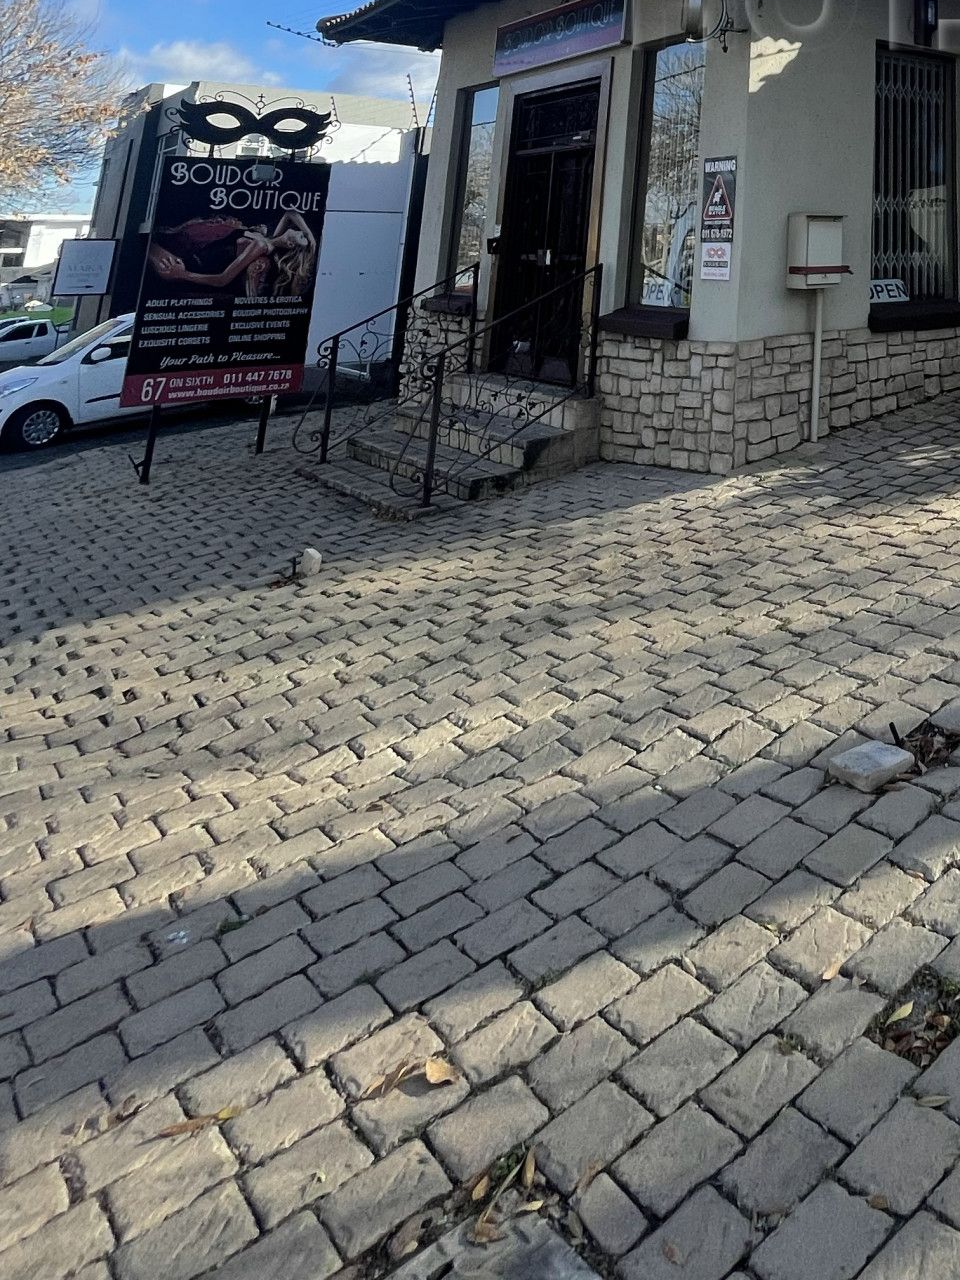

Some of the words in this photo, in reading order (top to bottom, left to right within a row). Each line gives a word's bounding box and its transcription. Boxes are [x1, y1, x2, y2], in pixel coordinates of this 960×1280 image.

[705, 160, 736, 172] WARNING
[209, 187, 321, 213] BOUTIQUE
[146, 299, 168, 307] ADULT
[170, 298, 213, 306] PLAYTHINGS
[234, 297, 268, 305] NOVELTIES
[276, 295, 302, 303] EROTICA
[143, 312, 176, 320] SENSUAL
[178, 310, 225, 319] ACCESSORIES
[232, 309, 262, 317] BOUDOIR
[263, 308, 308, 316] PHOTOGRAPHY
[141, 325, 176, 334] LUSCIOUS
[178, 323, 208, 332] LINGERIE
[230, 322, 265, 330] EXCLUSIVE
[266, 320, 290, 328] EVENTS
[138, 338, 175, 348] EXQUISITE
[177, 337, 210, 345] CORSETS
[253, 333, 286, 341] SHOPPING
[160, 356, 187, 369] Your
[188, 353, 214, 364] Path
[217, 354, 228, 362] to
[230, 351, 281, 361] Pleasure...
[169, 378, 184, 388] ON
[185, 376, 214, 387] SIXTH
[223, 373, 242, 384] 011
[245, 371, 264, 381] 447
[268, 369, 292, 380] 7678
[140, 378, 167, 402] 67
